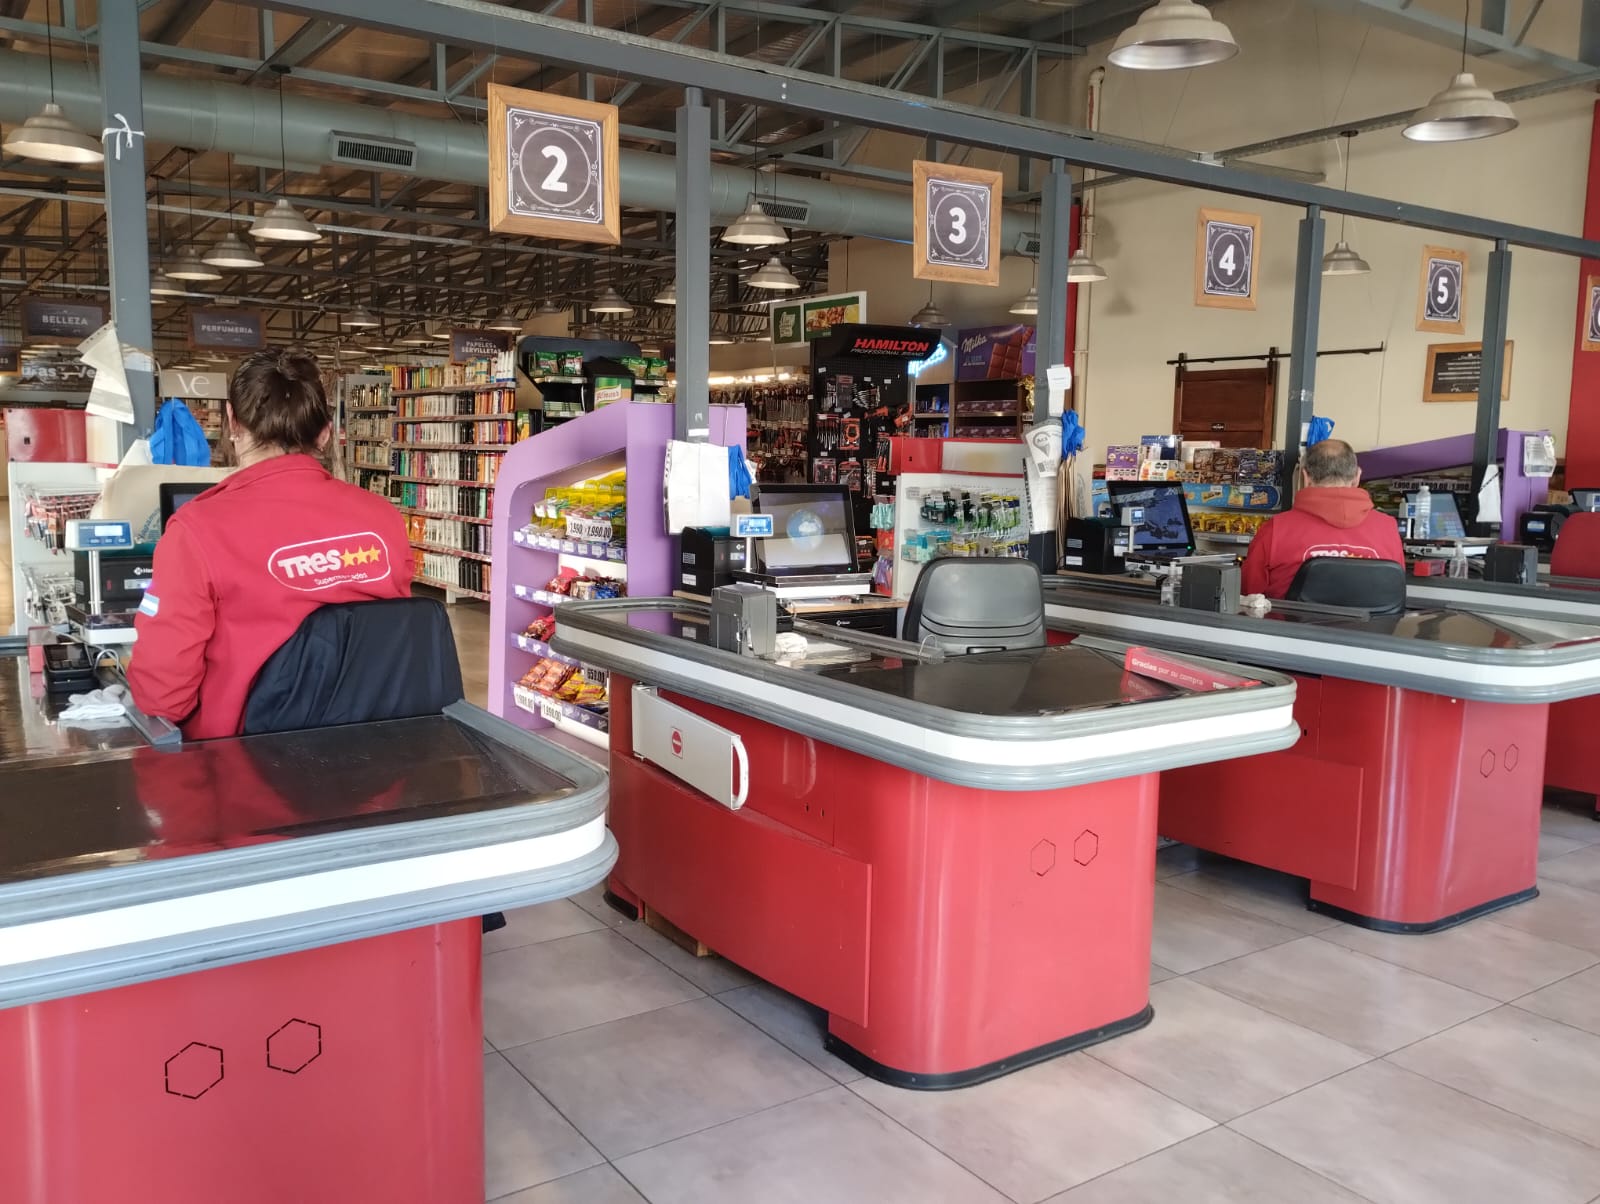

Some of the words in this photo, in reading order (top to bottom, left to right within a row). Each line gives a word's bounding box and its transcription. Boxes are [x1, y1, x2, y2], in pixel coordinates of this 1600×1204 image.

[541, 145, 568, 193] 2
[949, 206, 967, 244] 3
[1219, 244, 1236, 276] 4
[1436, 276, 1449, 305] 5
[41, 314, 89, 327] BELLEZA
[201, 324, 253, 335] PERFUMERIA
[465, 340, 493, 348] PAPELES
[854, 337, 930, 352] HAMILTON
[961, 333, 988, 353] Milka
[1131, 657, 1158, 672] Gracias
